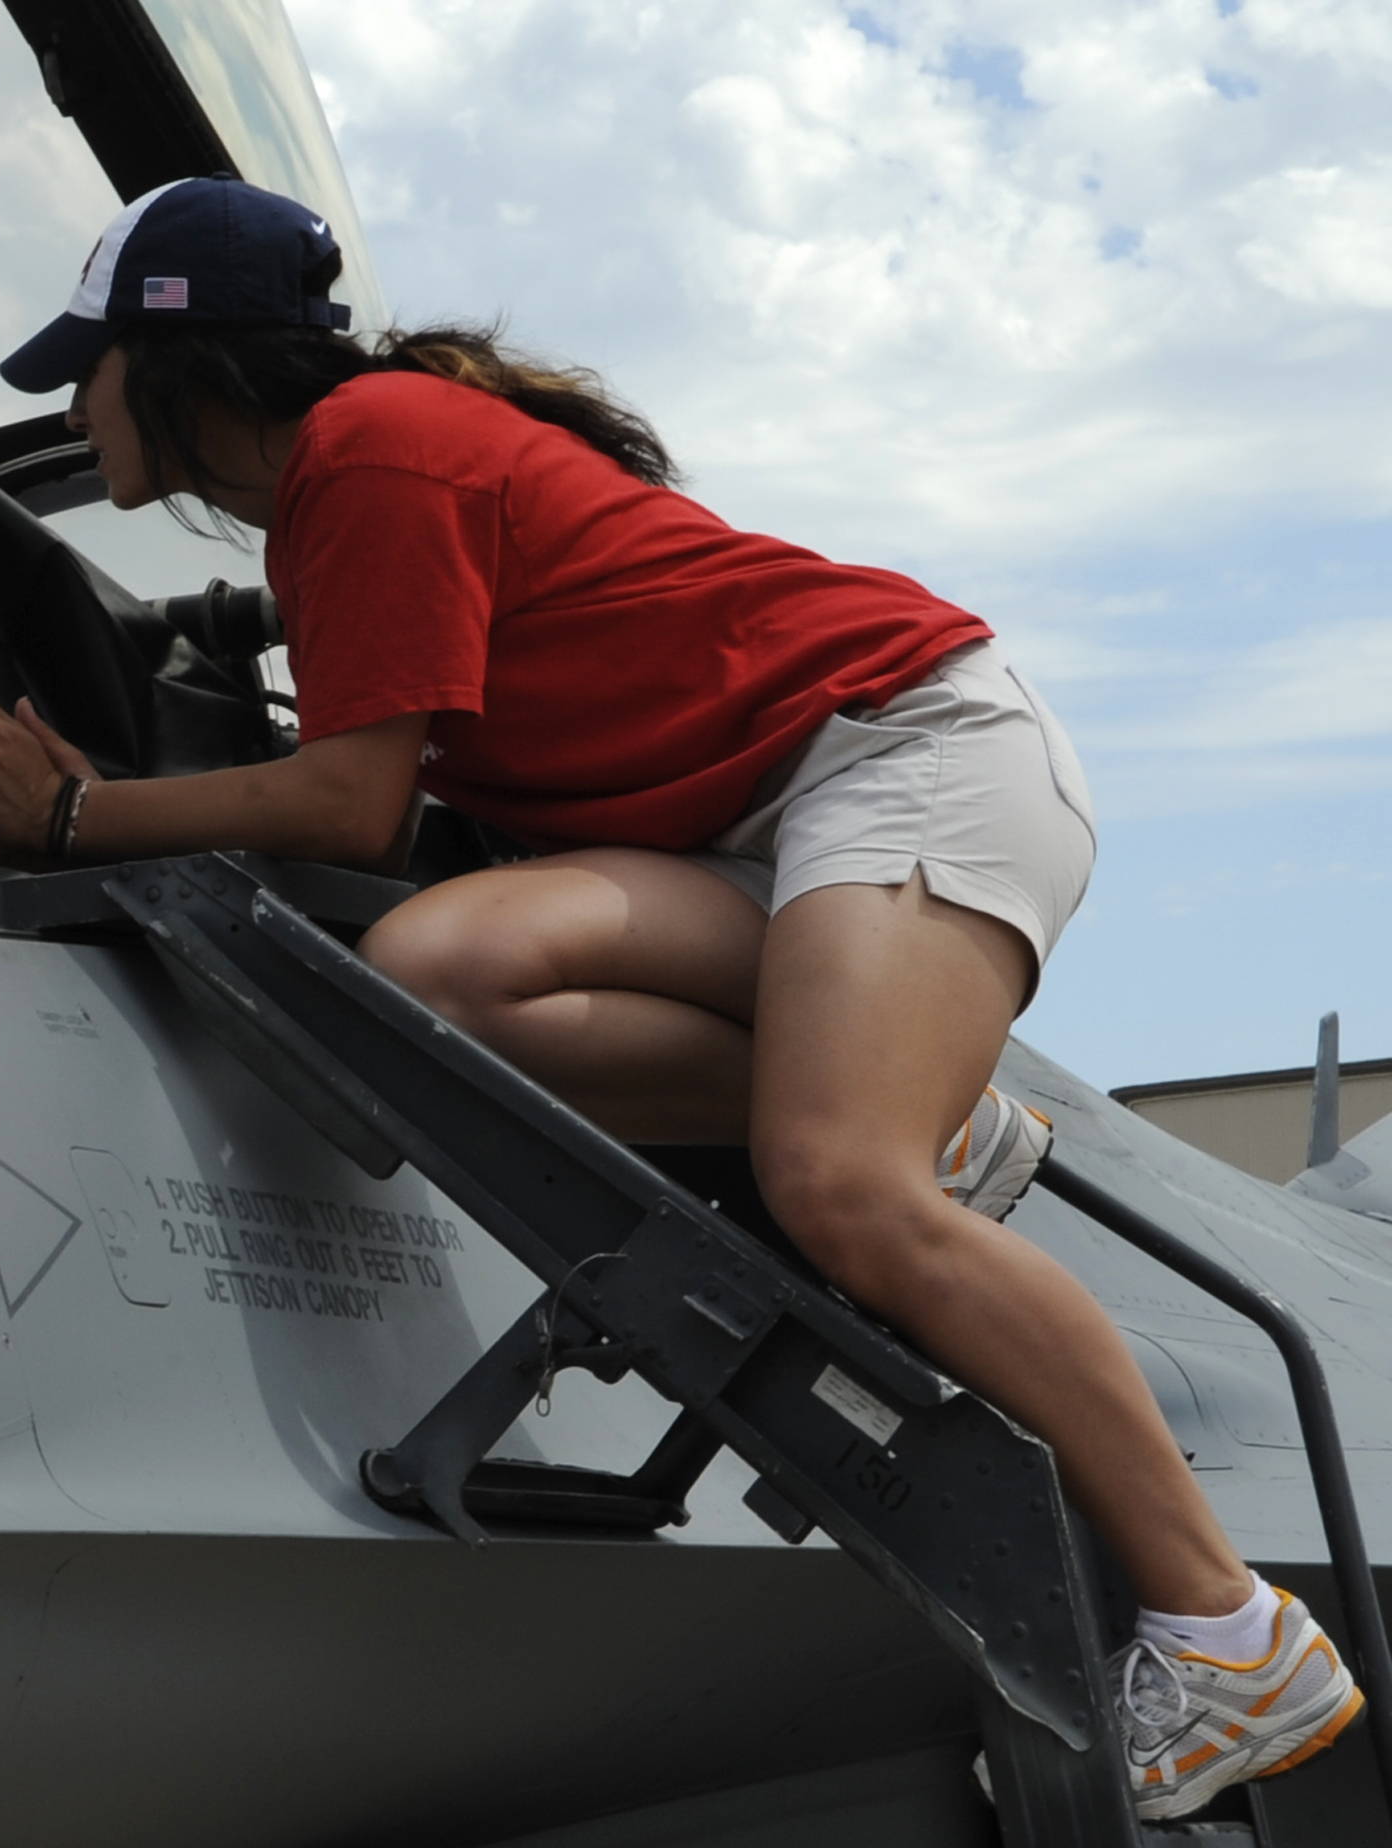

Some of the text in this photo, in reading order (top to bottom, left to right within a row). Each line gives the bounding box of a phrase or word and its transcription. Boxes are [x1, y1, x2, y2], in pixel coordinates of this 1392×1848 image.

[145, 1174, 465, 1252] 1. PUSH BUTTON TO OPEN DOOR
[162, 1217, 443, 1289] 2. PULL RING OUT 6 FEET TO
[204, 1267, 385, 1323] JETTISON CANOPY
